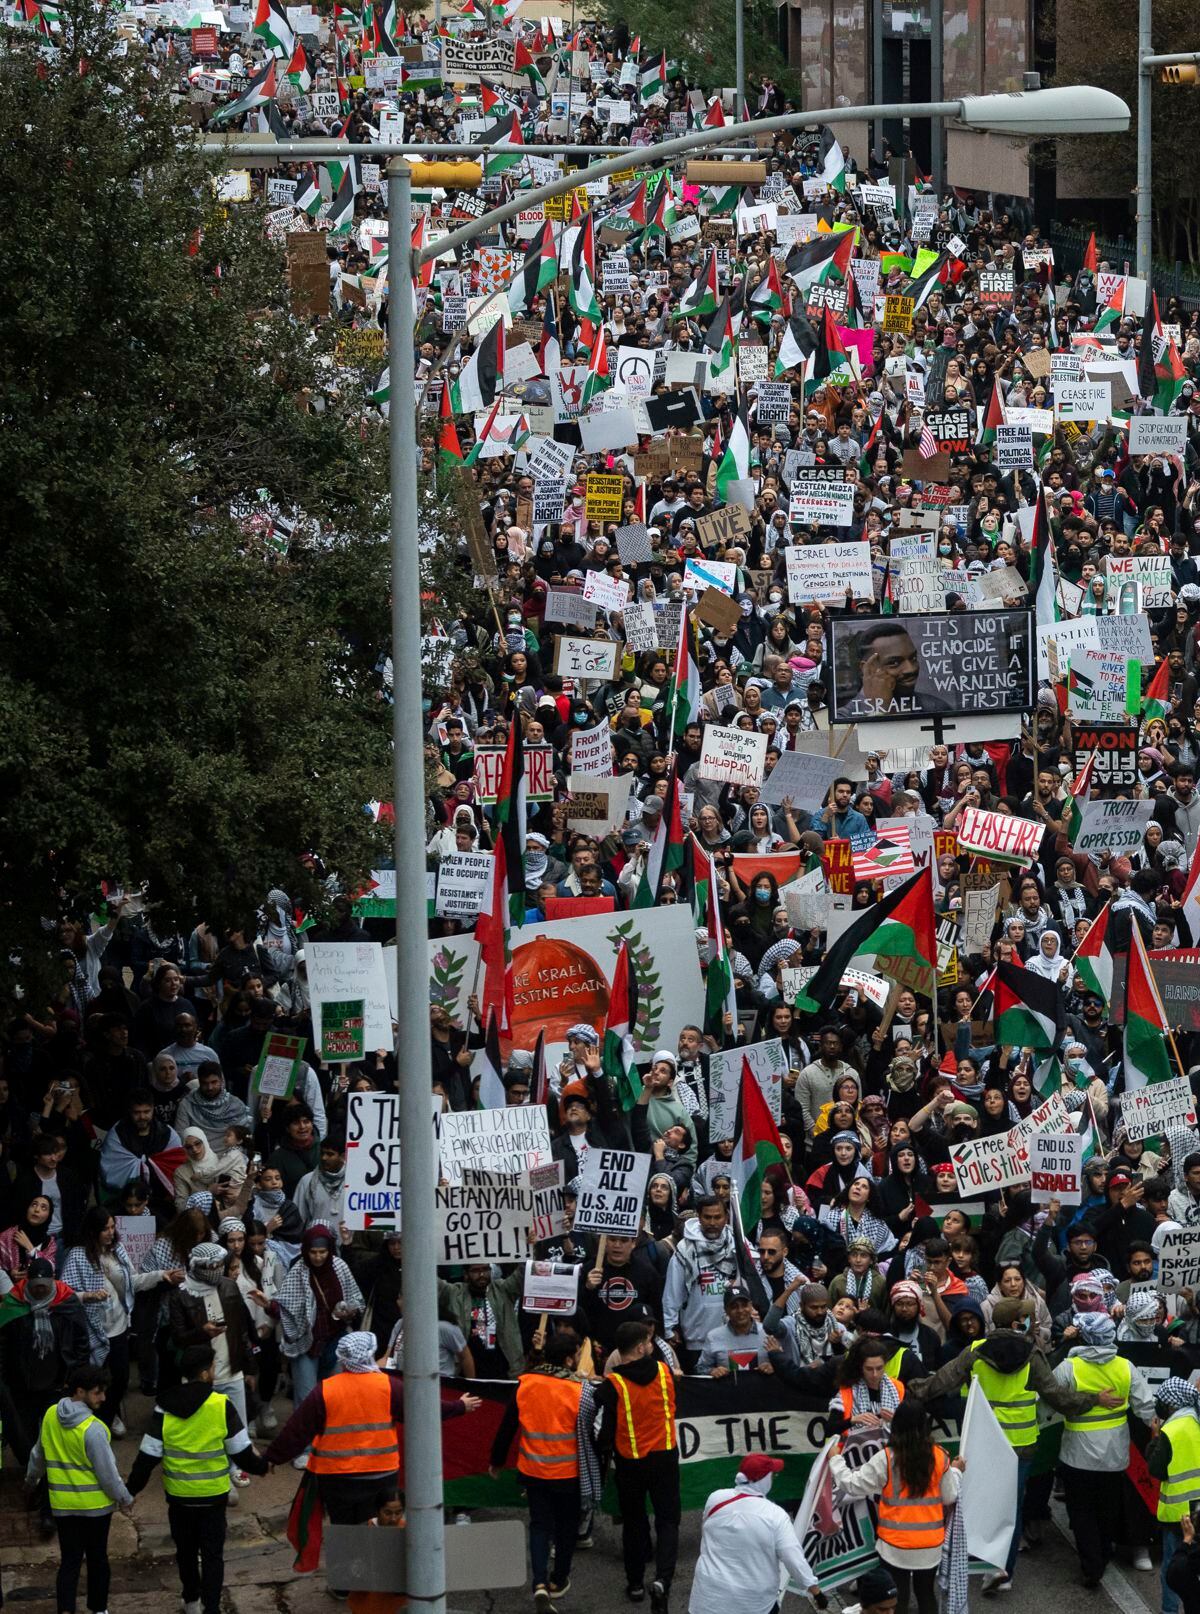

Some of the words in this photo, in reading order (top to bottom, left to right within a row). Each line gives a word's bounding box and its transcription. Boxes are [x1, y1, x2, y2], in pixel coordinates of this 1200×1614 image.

[318, 96, 337, 105] END
[458, 191, 487, 209] CEASE
[454, 197, 484, 218] FIRE
[519, 212, 544, 221] BLOOD
[980, 273, 1014, 281] CEASE
[980, 280, 1014, 292] FIRE
[811, 286, 846, 300] CEASE
[808, 293, 845, 311] FIRE
[901, 297, 912, 307] ALL
[1062, 389, 1087, 399] CEASE
[1089, 388, 1106, 399] FIRE
[1075, 402, 1095, 411] NOW
[760, 410, 788, 420] RIGHT!
[926, 412, 968, 425] CEASE
[998, 427, 1016, 437] FREE
[1017, 427, 1031, 436] ALL
[1139, 423, 1156, 434] STOP
[998, 435, 1031, 444] PALESTINIAN
[1138, 436, 1151, 445] END
[999, 447, 1031, 457] POLITICAL
[999, 456, 1032, 465] PRISONERS
[799, 469, 845, 480] CEASE
[588, 477, 622, 486] RESISTANCE
[828, 483, 852, 493] MEDIA
[535, 508, 562, 520] RIGHT!
[699, 514, 713, 526] LET
[719, 505, 741, 518] GAZA
[808, 511, 838, 521] HISTORY
[702, 513, 745, 544] LIVE
[795, 547, 830, 561] ISRAEL
[1110, 559, 1134, 573] WE
[1138, 557, 1171, 571] WILL
[801, 572, 829, 580] COMMIT
[832, 570, 870, 578] PALESTINIAN
[922, 620, 958, 637] IT'S
[974, 616, 1010, 634] NOT
[921, 638, 996, 658] GENOCIDE
[1010, 634, 1023, 649] IF
[925, 658, 951, 674] WE
[961, 656, 997, 672] GIVE
[1009, 655, 1022, 669] A
[1109, 654, 1125, 664] THE
[1102, 663, 1125, 674] RIVER
[1099, 672, 1109, 682] TO
[1110, 674, 1125, 685] THE
[1108, 683, 1125, 692] SEA
[961, 690, 1011, 709] FIRST
[1085, 688, 1127, 703] PALESTINE
[850, 695, 923, 716] ISRAEL
[1076, 701, 1099, 711] WILL
[1101, 702, 1112, 711] BE
[576, 733, 599, 747] FROM
[575, 746, 599, 760] RIVER
[583, 759, 599, 771] THE
[600, 755, 612, 768] SEA
[1103, 801, 1140, 817] TRUTH
[959, 808, 1044, 858] CEASEFIRE
[1080, 829, 1142, 849] OPPRESSED
[465, 857, 490, 869] PEOPLE
[442, 867, 455, 878] ARE
[538, 964, 587, 984] ISRAEL
[1128, 1126, 1146, 1142] CRY
[1037, 1139, 1057, 1153] END
[600, 1151, 635, 1173] END
[1041, 1157, 1057, 1171] AID
[1057, 1158, 1071, 1172] TO
[599, 1171, 628, 1192] ALL
[614, 1195, 639, 1213] AID
[446, 1211, 475, 1233] GO
[476, 1211, 501, 1231] TO
[579, 1210, 592, 1222] TO
[1177, 1247, 1191, 1257] IS
[715, 1414, 792, 1454] THE
